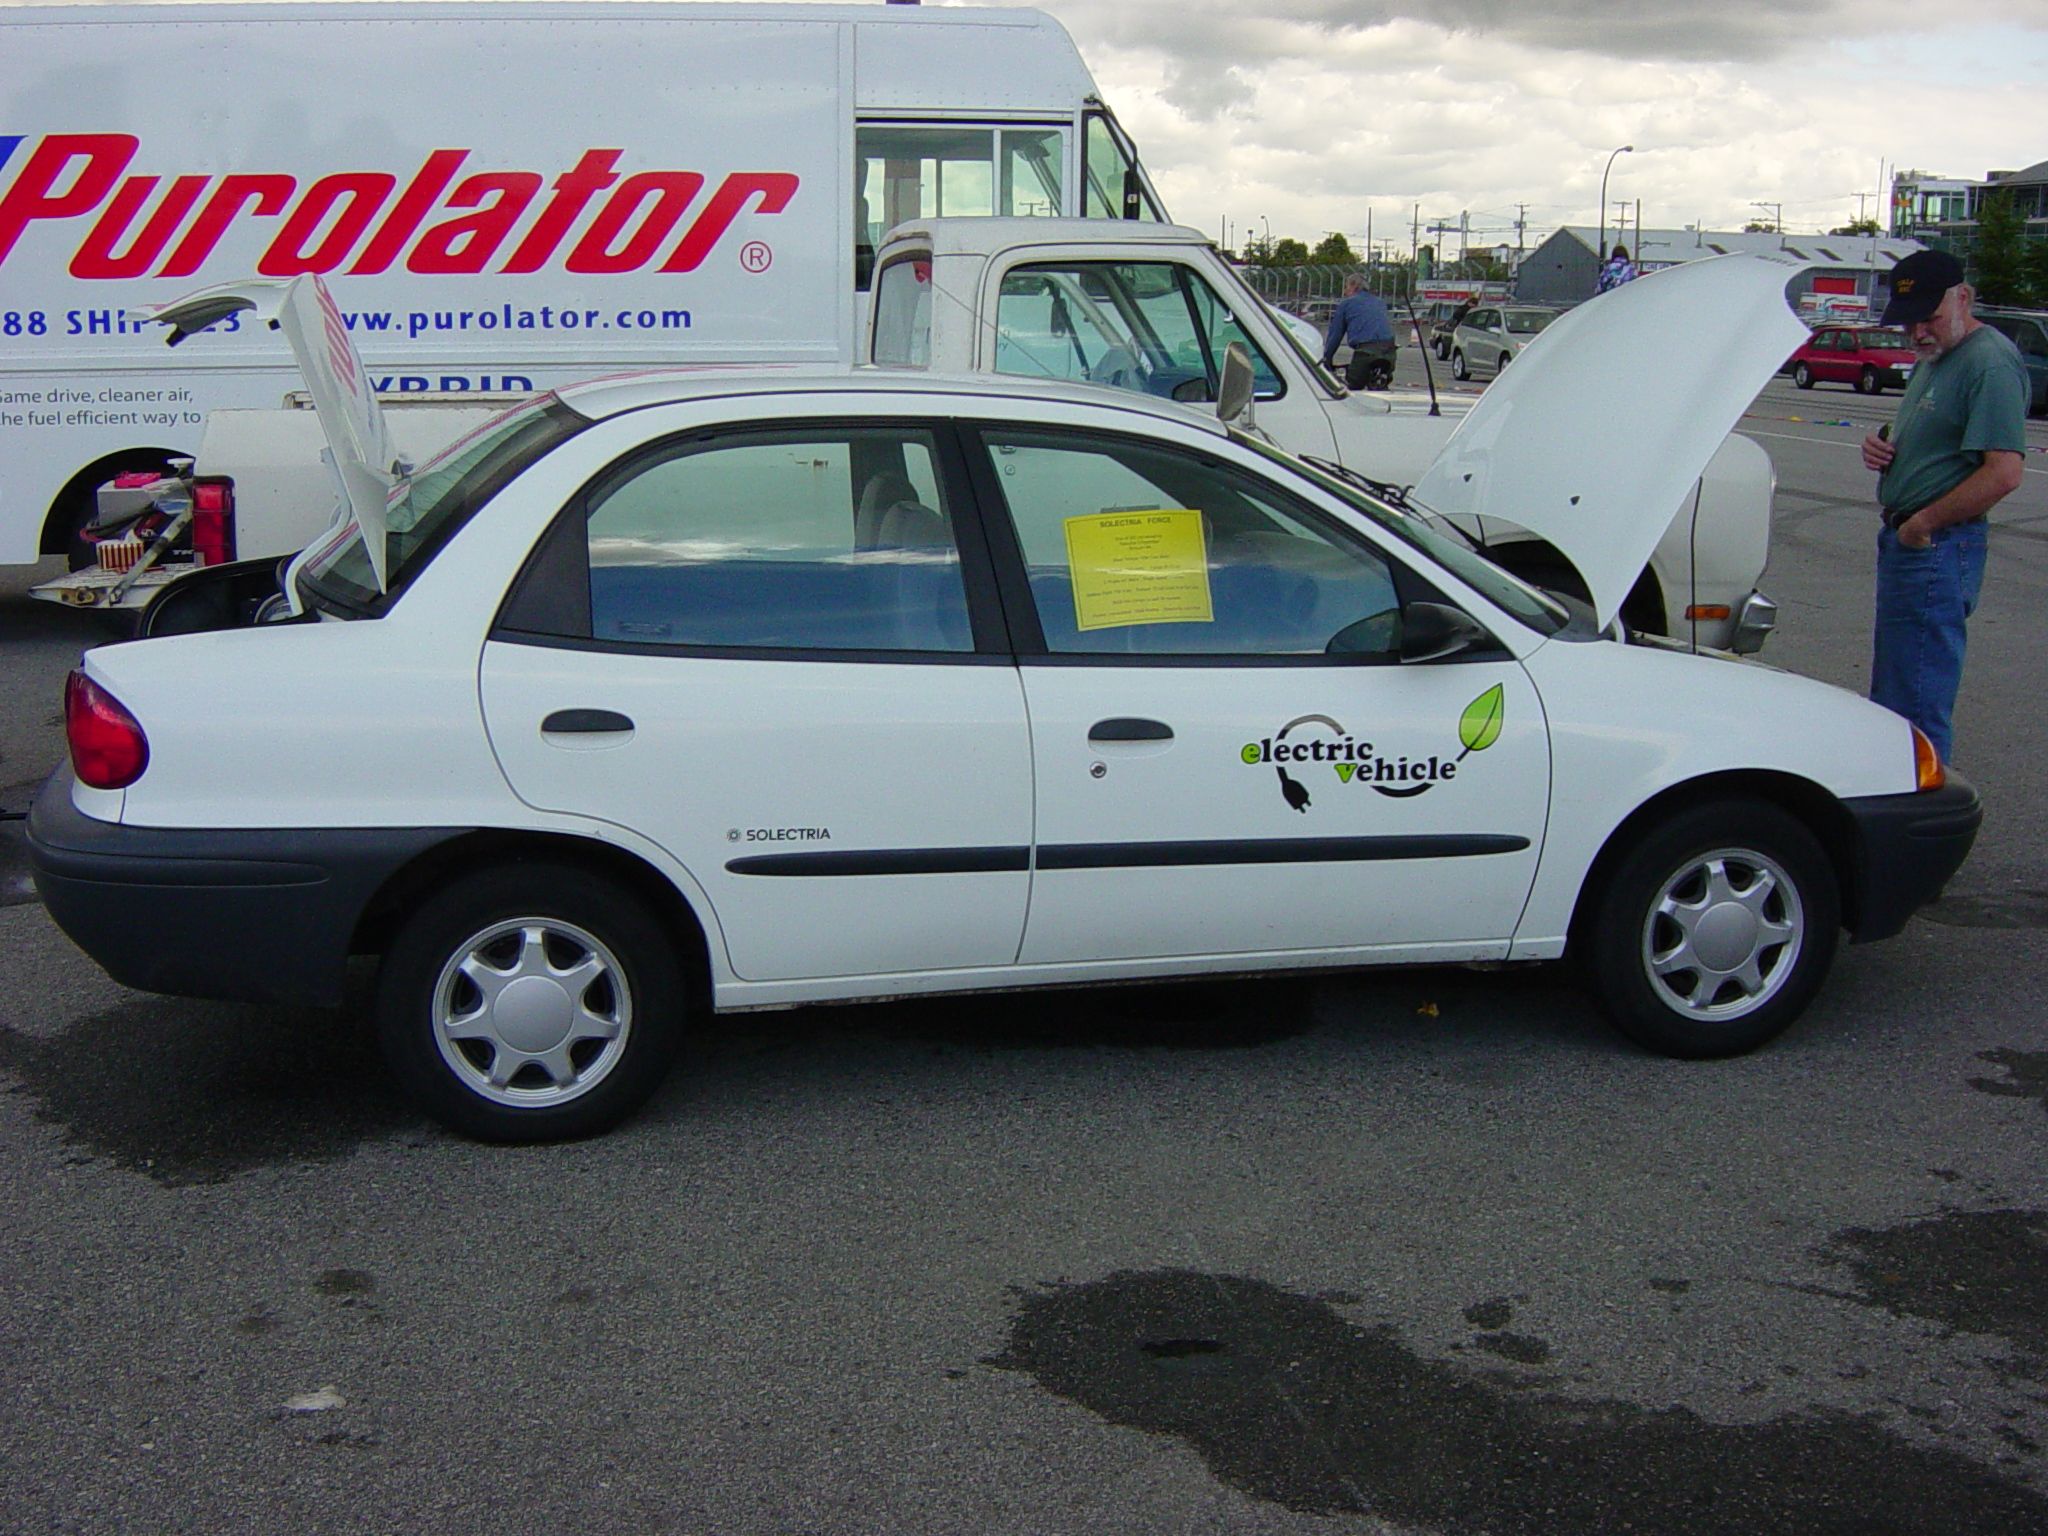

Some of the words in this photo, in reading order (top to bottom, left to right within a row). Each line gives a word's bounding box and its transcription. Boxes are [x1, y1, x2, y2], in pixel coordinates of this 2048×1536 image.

[0, 134, 799, 279] Purolator
[3, 311, 48, 336] 88
[47, 388, 95, 404] drive,
[98, 388, 163, 402] cleaner
[168, 388, 193, 404] air,
[0, 411, 23, 425] he
[28, 411, 61, 425] fuel
[66, 411, 137, 425] efficient
[143, 413, 178, 429] way
[183, 411, 201, 424] to
[1241, 737, 1373, 764] electric
[1334, 756, 1456, 783] vehicle
[746, 828, 831, 842] SOLECTRIA
